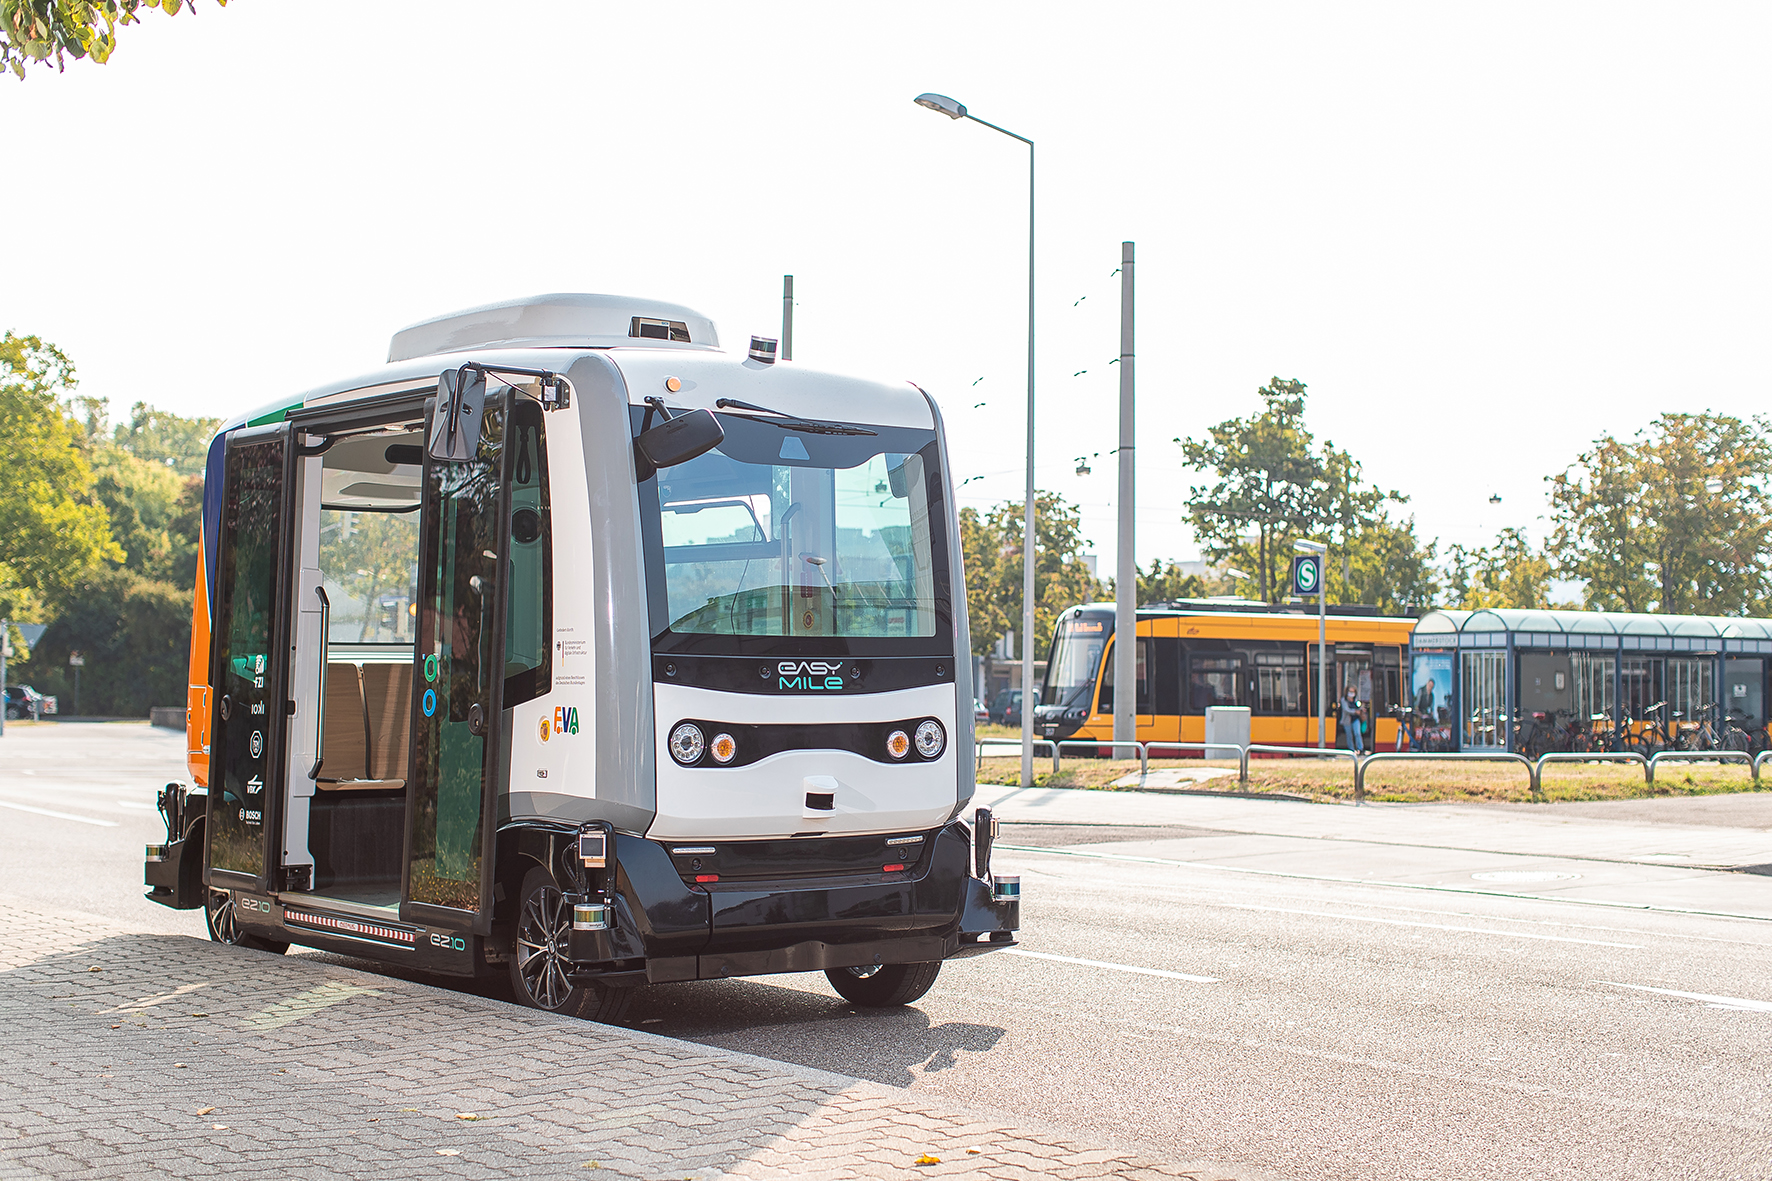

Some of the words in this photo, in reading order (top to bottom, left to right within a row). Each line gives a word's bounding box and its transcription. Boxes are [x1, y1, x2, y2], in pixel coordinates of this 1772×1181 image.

[1301, 563, 1315, 587] S
[554, 706, 579, 735] EVA
[245, 810, 262, 820] BOSCH
